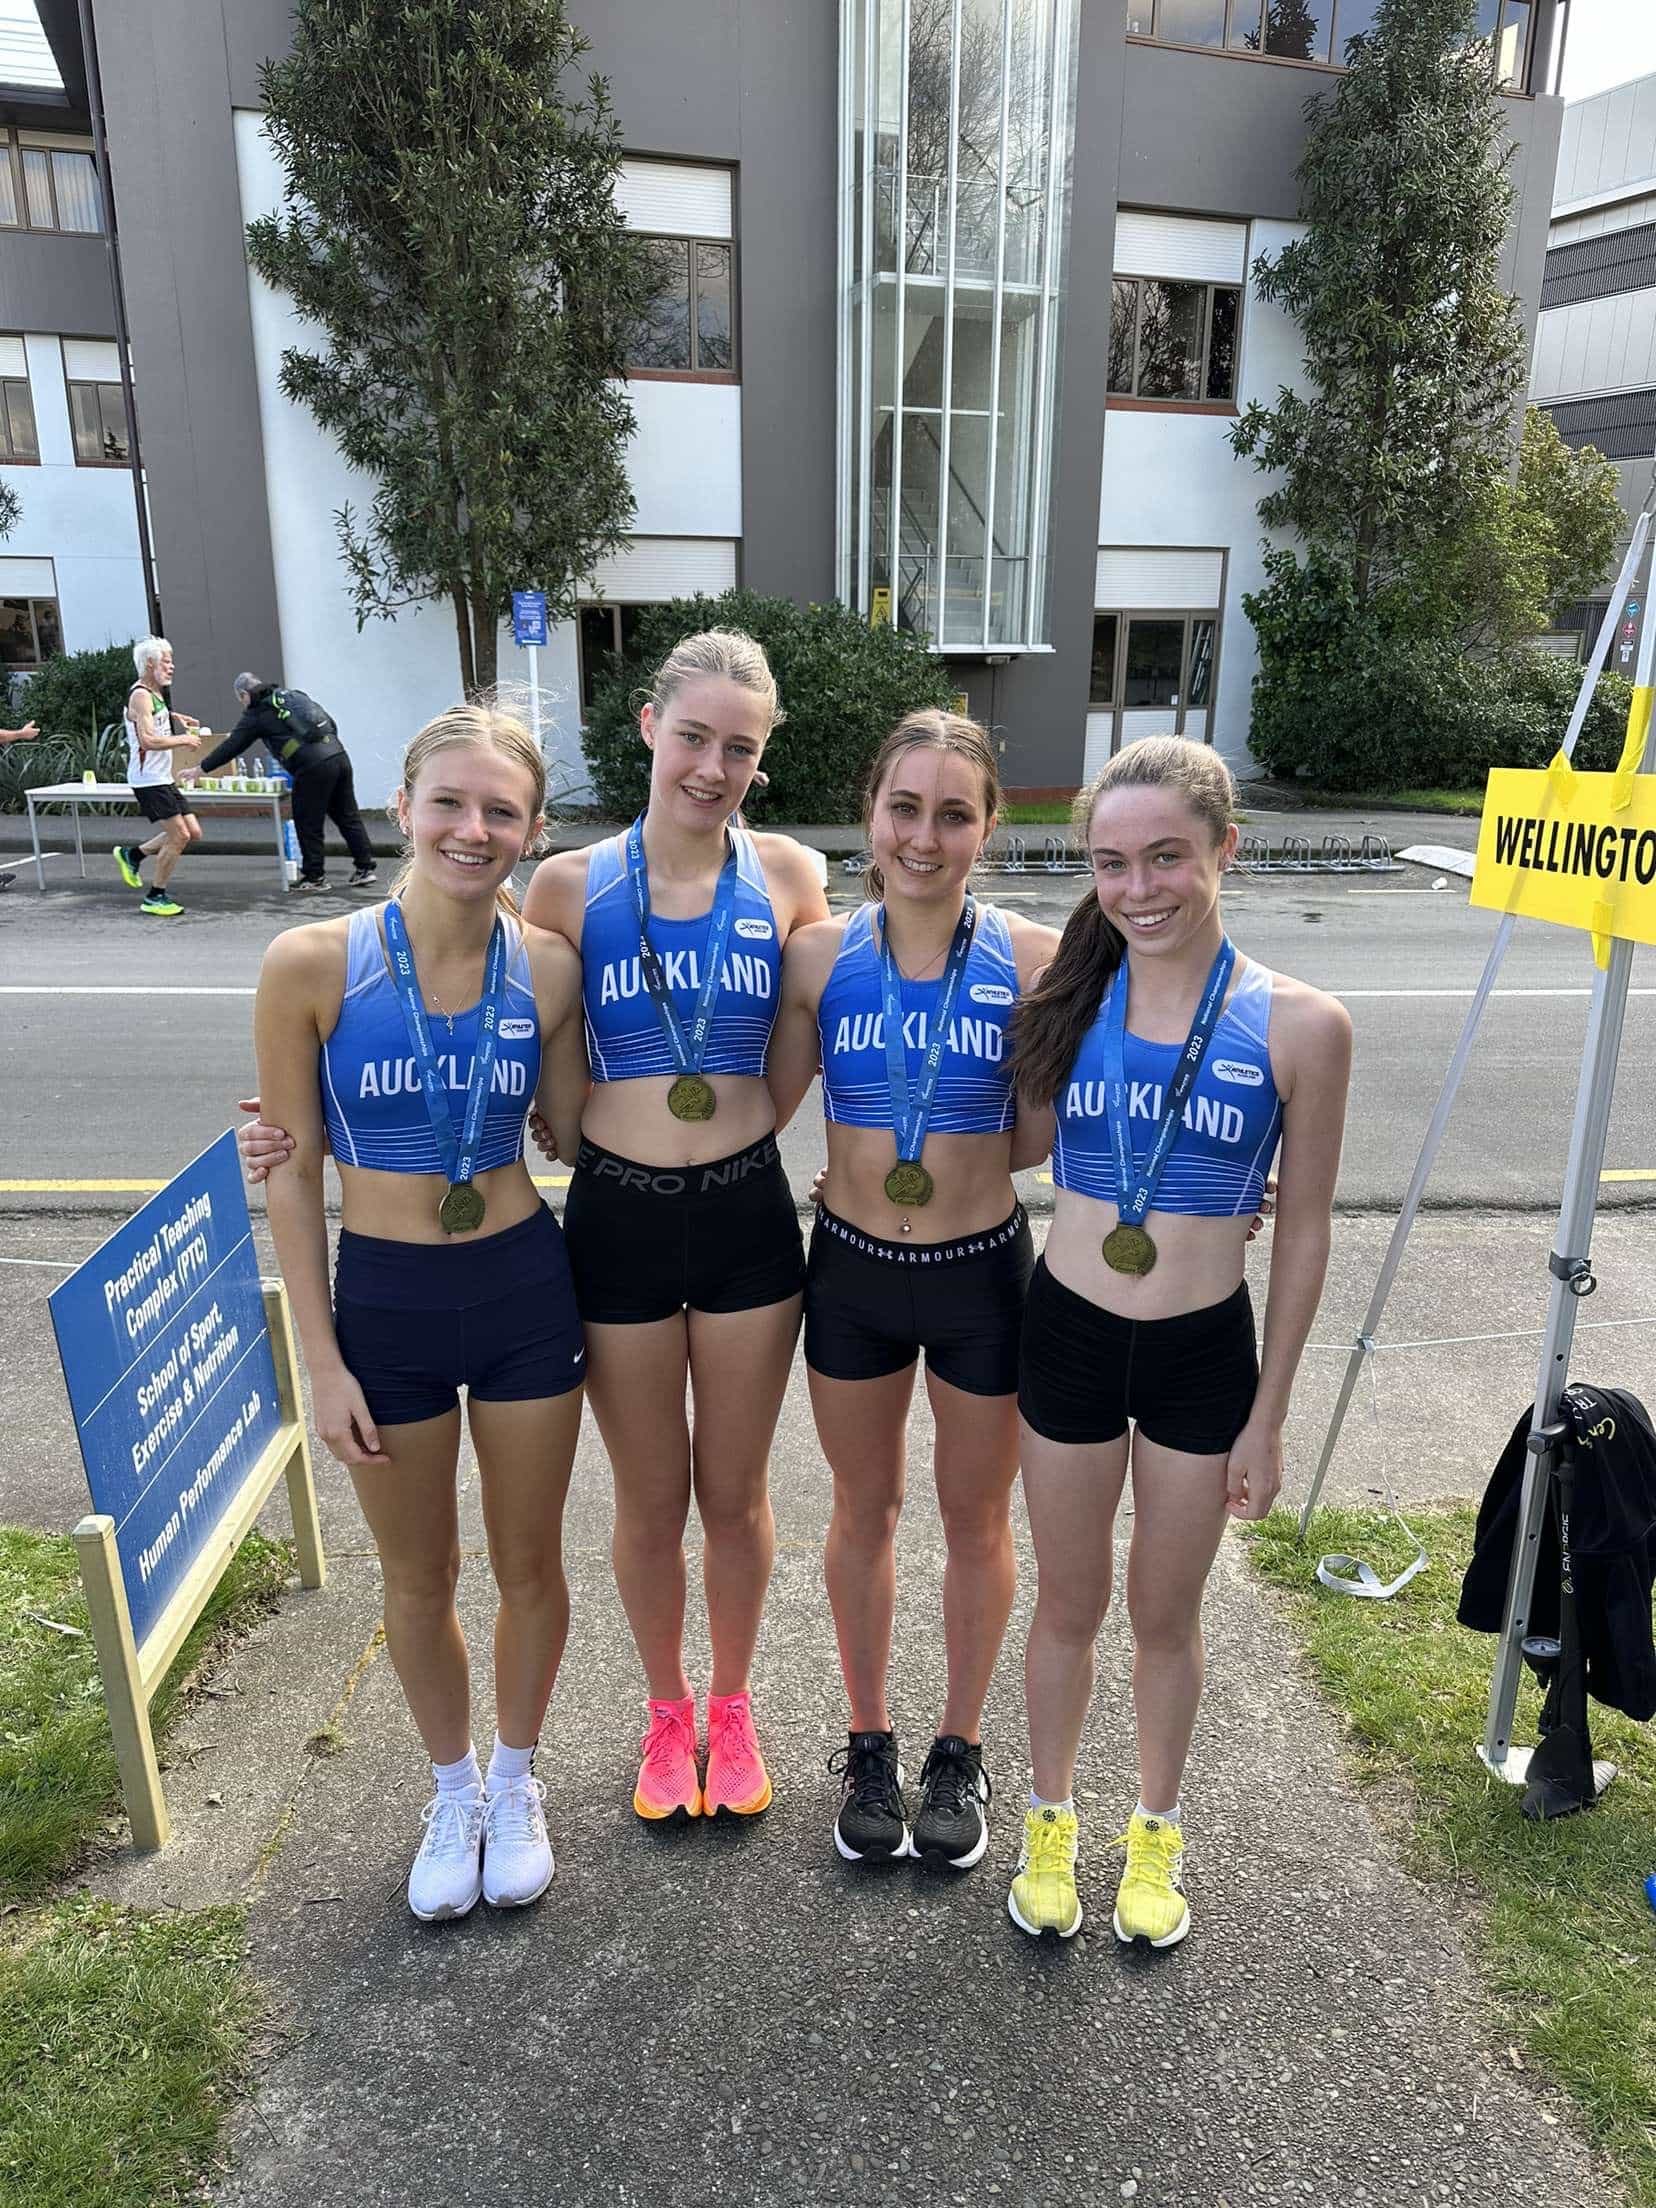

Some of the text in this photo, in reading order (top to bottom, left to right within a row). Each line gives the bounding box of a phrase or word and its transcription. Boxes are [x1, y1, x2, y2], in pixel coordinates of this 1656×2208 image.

[1495, 815, 1656, 885] WELLINGTO
[396, 951, 410, 976] 2023
[484, 1005, 495, 1030] 2023
[693, 1018, 706, 1042] 2023
[928, 1042, 941, 1067] 2023
[1186, 1034, 1204, 1062] 2023
[1066, 1080, 1244, 1144] AUKLAND
[459, 1156, 472, 1180] 2023
[592, 1141, 779, 1195] PRO NIKE
[1132, 1187, 1148, 1213] 2023
[104, 1191, 212, 1313] Practical Teaching
[823, 1218, 874, 1256] ARMOUR
[897, 1246, 966, 1264] ARMOUR
[125, 1231, 208, 1337] Complex (PTC)
[137, 1348, 179, 1417] School
[179, 1331, 191, 1366] of
[131, 1325, 239, 1474] Exercise & Nutrition
[138, 1390, 261, 1583] Human Performance Lab
